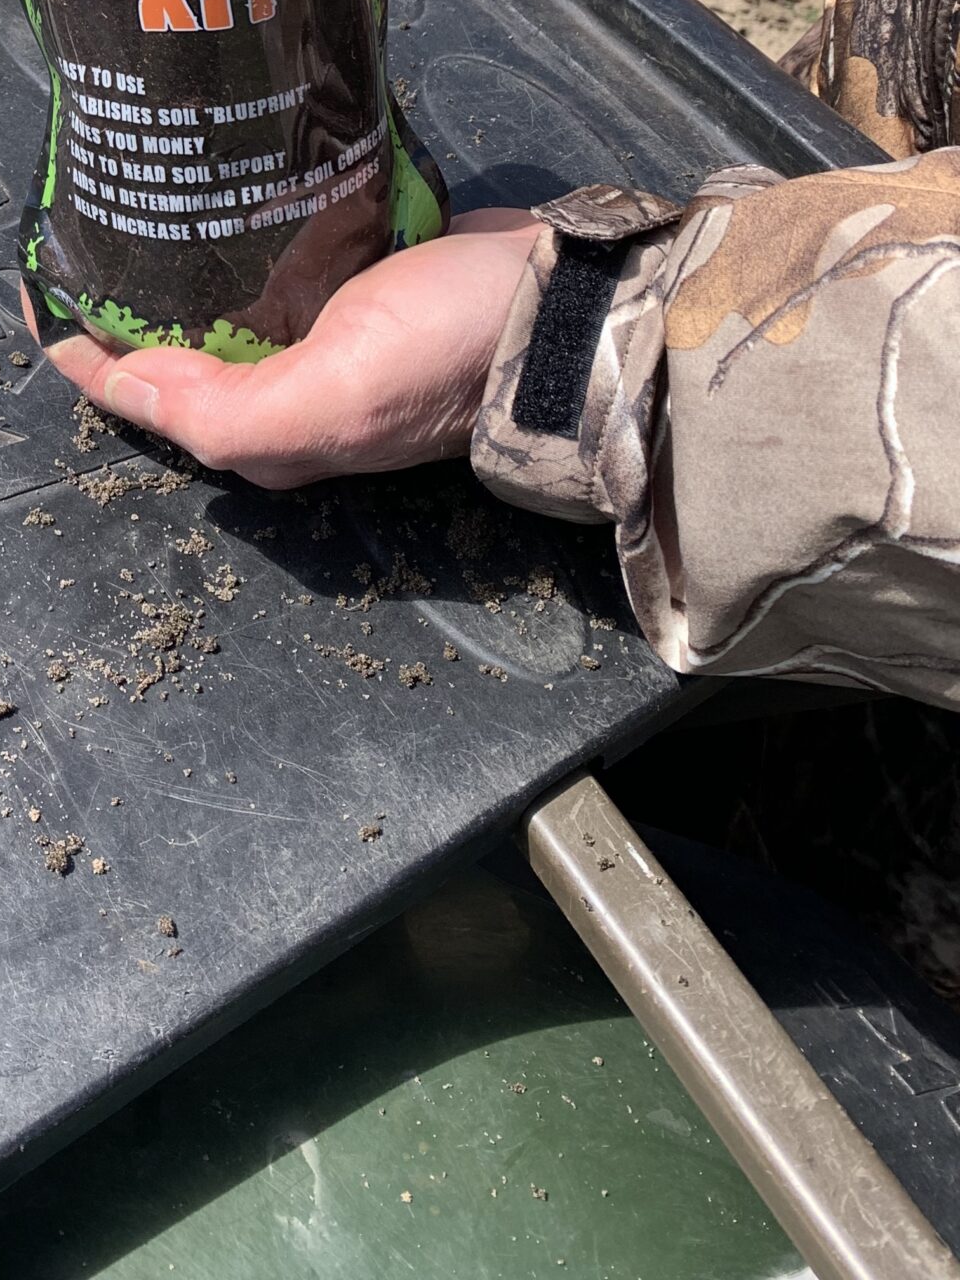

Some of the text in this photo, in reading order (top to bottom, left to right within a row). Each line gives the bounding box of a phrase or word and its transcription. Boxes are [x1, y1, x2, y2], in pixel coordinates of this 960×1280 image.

[92, 66, 112, 88] TO
[116, 72, 146, 96] USE
[71, 82, 312, 126] ABLISHES SOIL "BLUEPRINT"
[70, 139, 286, 184] EASY TO READ SOIL REPORT
[105, 129, 138, 152] YOU
[142, 135, 205, 156] MONEY
[73, 167, 97, 196] AIDS
[99, 182, 116, 202] IN
[119, 189, 237, 213] DETERMINING
[241, 175, 299, 205] EXACT
[304, 160, 335, 188] SOIL
[74, 156, 380, 241] HELPS INCREASE YOUR GROWING SUCCESS
